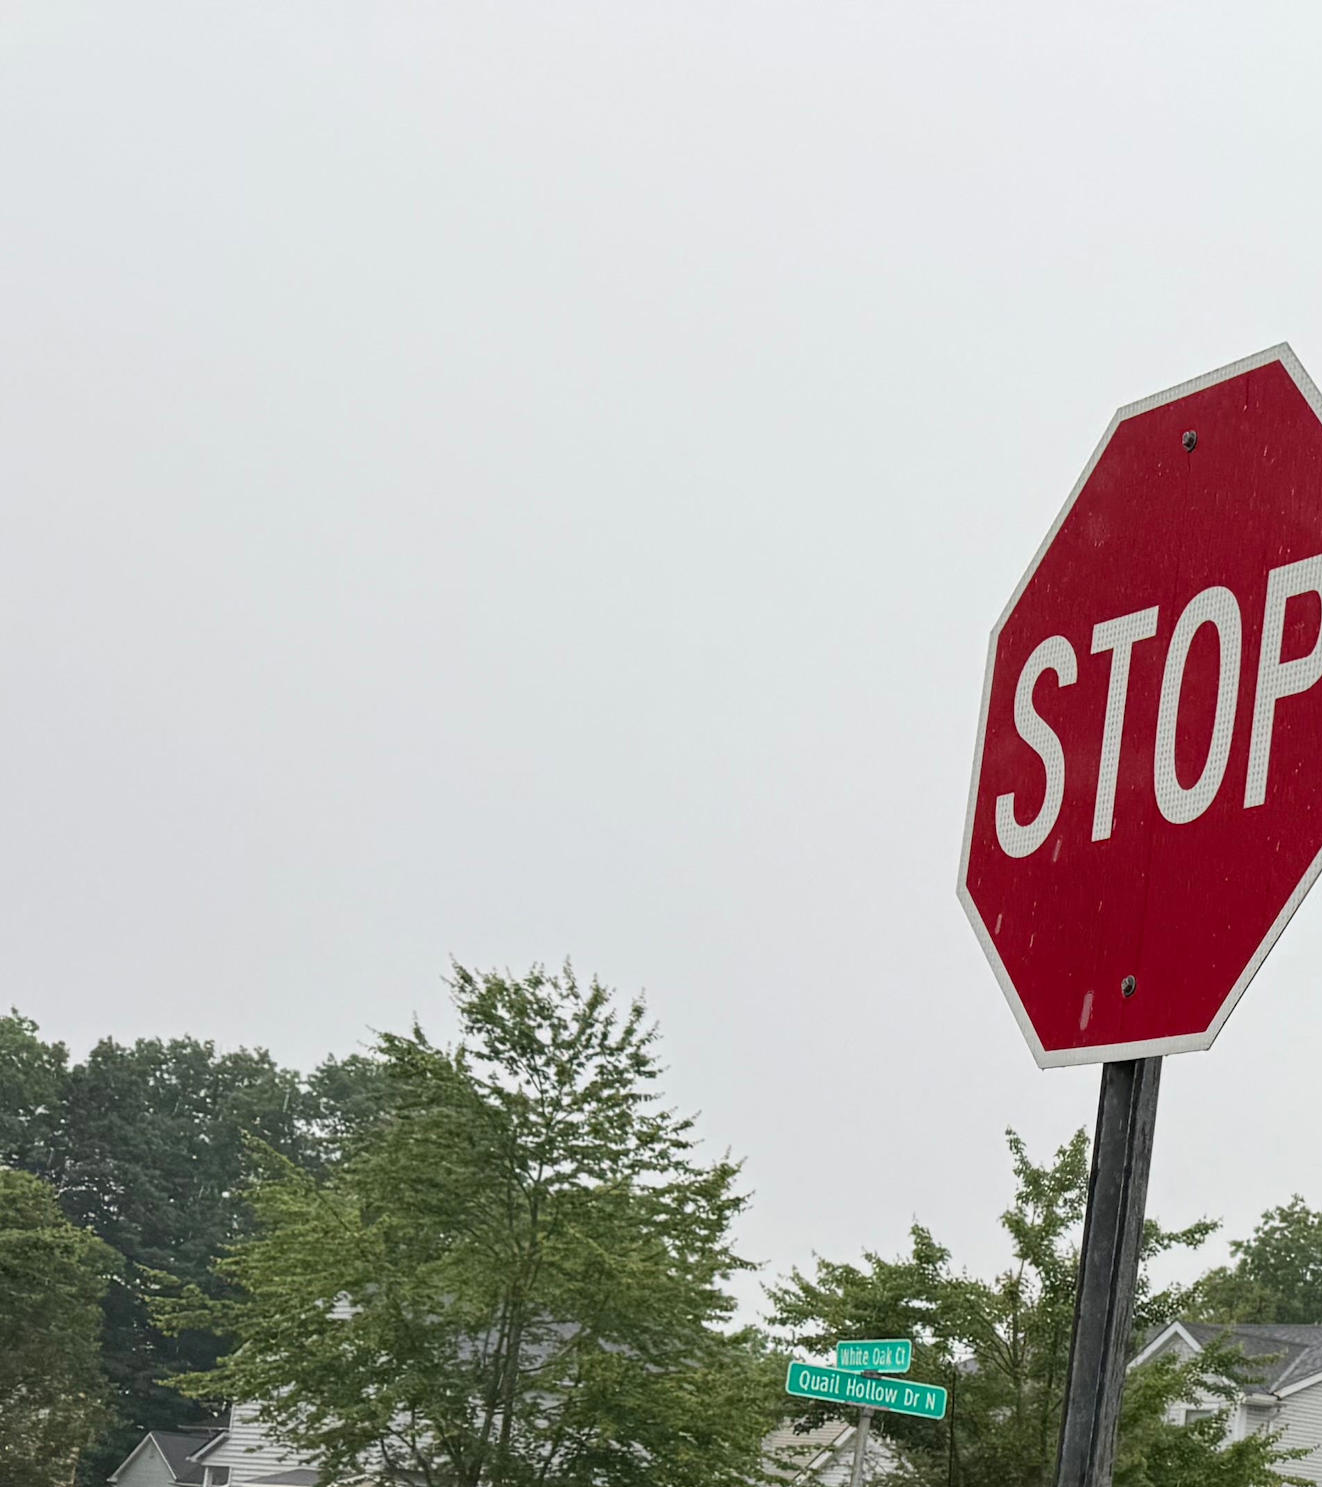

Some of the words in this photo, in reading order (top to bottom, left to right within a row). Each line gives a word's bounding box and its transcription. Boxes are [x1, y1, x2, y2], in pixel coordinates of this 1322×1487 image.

[840, 1348, 869, 1366] White
[873, 1347, 892, 1366] Oak
[895, 1346, 906, 1365] Ct
[799, 1370, 840, 1395] Quail
[846, 1379, 898, 1404] Hollow
[903, 1387, 920, 1408] Dr
[925, 1392, 936, 1411] N
